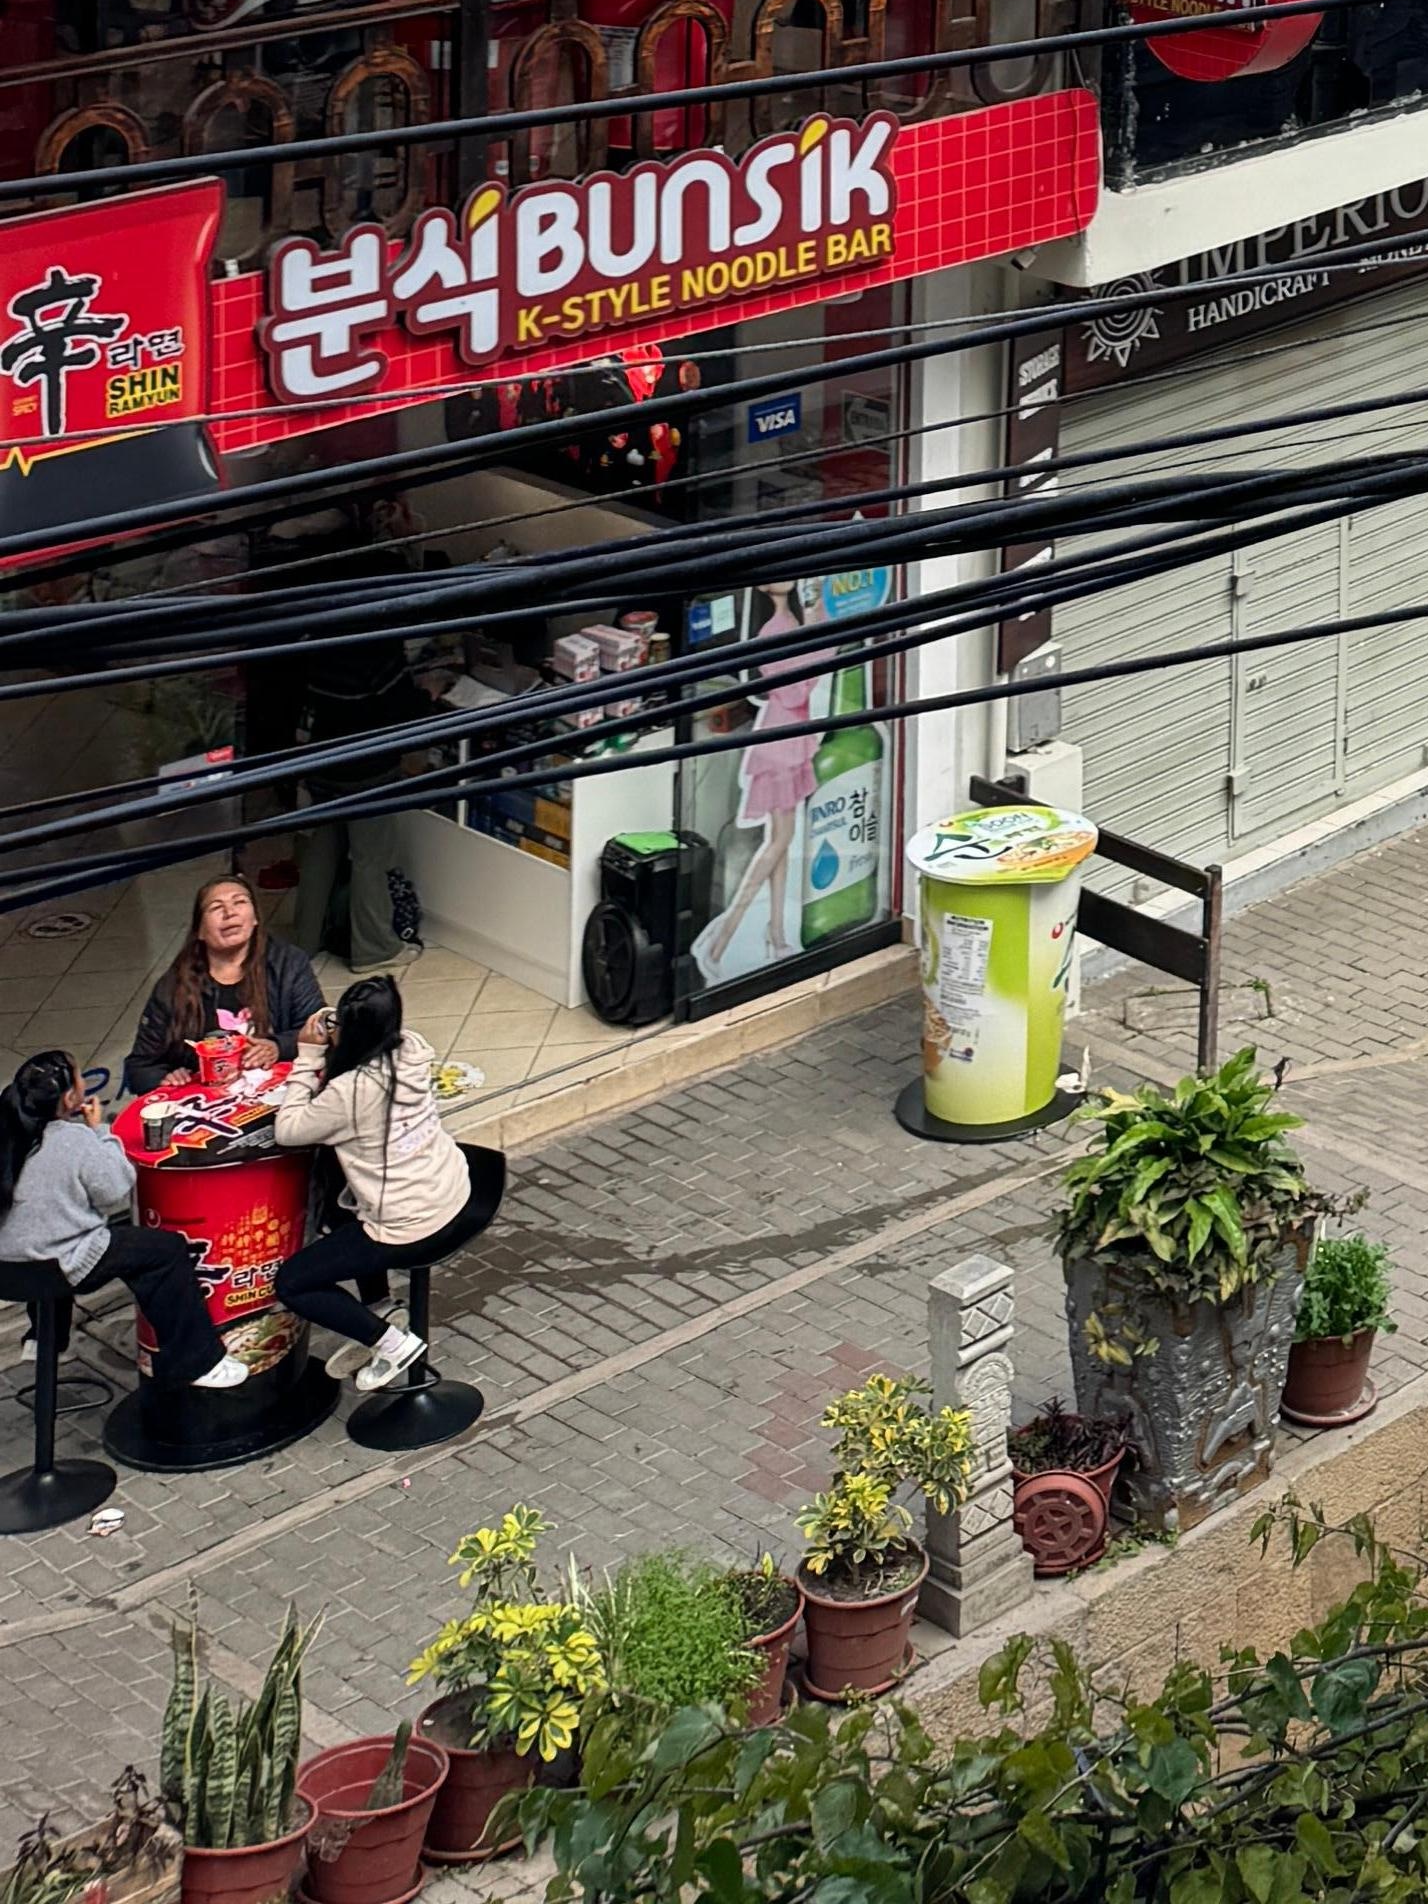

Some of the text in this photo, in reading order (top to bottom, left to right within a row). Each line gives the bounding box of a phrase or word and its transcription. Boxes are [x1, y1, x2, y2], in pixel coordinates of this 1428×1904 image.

[272, 189, 500, 397] 분식
[517, 222, 892, 342] K-STYLE NOODLE BAR
[0, 266, 127, 436] 辛
[107, 387, 181, 416] RAMYUN
[108, 364, 180, 402] SHIN
[755, 408, 796, 433] VISA
[226, 1290, 257, 1305] SHIN
